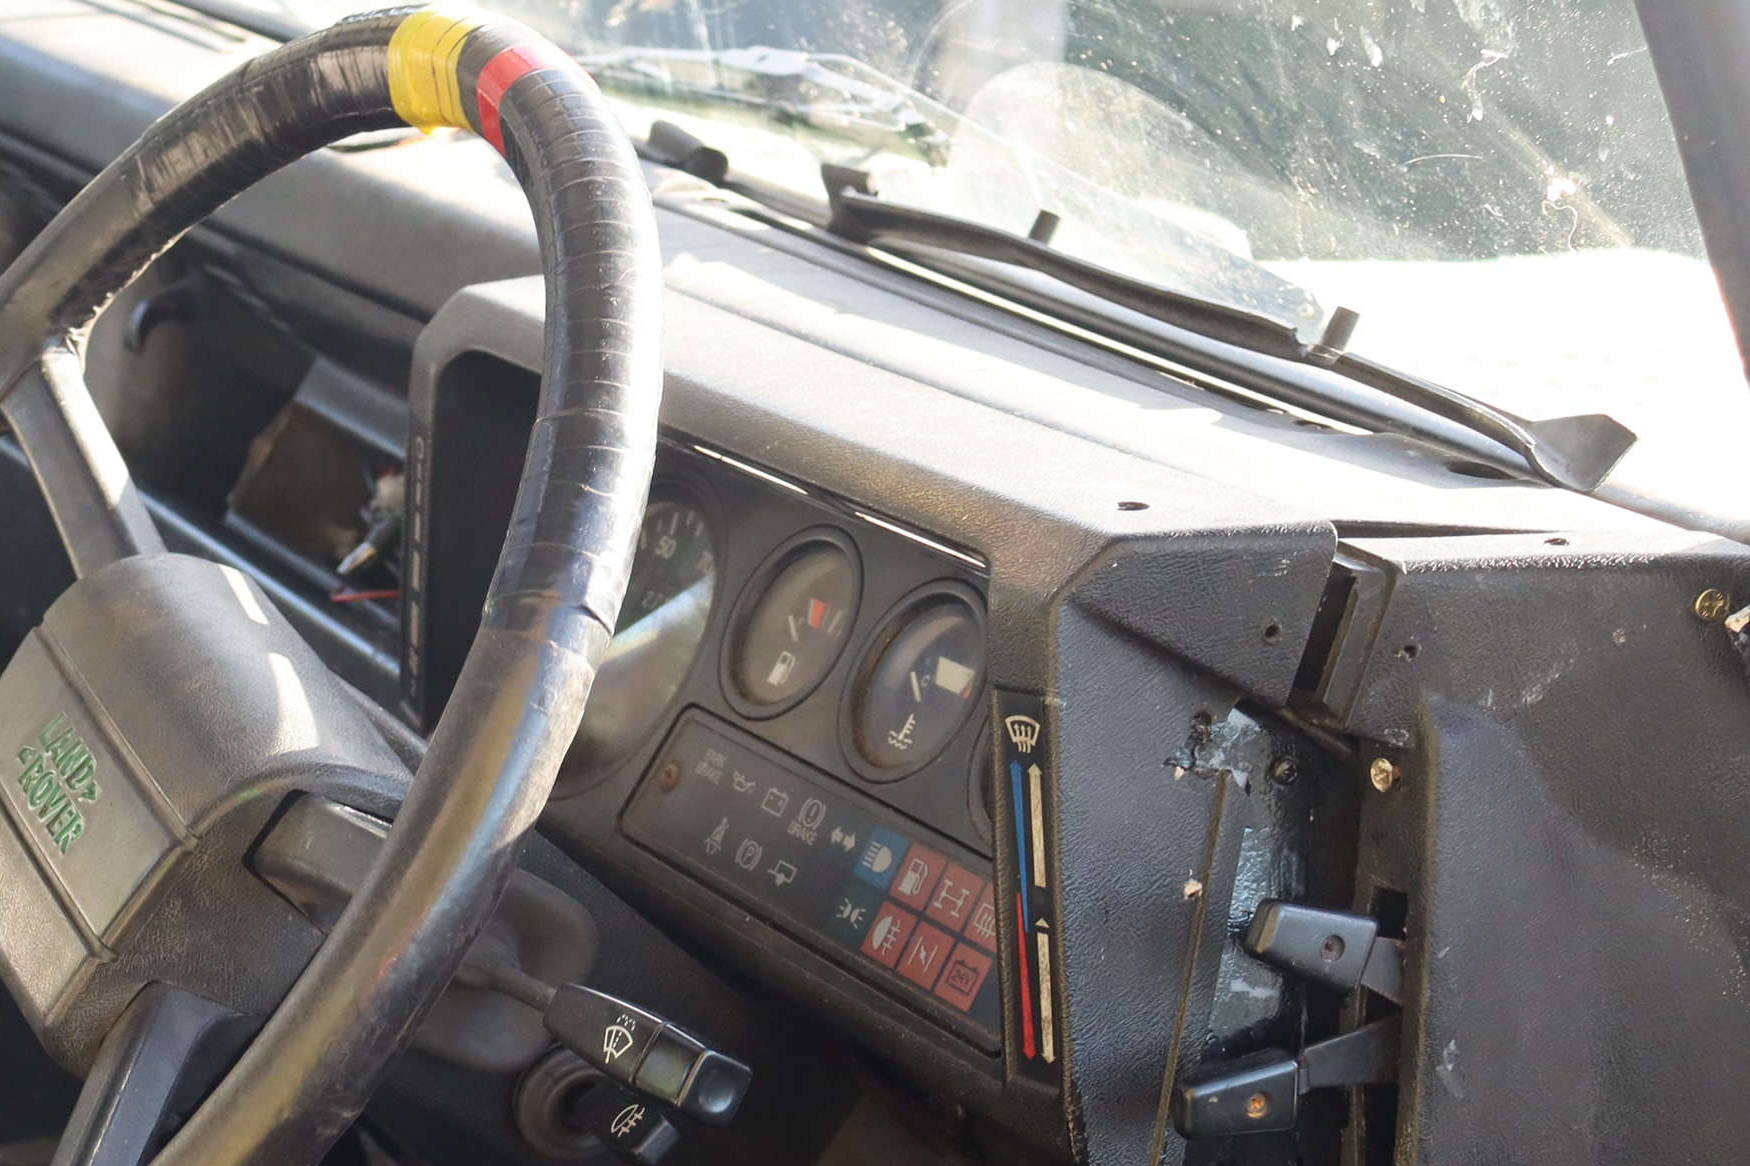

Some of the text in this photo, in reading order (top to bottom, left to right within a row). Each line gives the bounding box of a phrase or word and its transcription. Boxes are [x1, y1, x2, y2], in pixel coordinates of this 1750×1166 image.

[655, 535, 678, 559] 50
[38, 710, 97, 792] LAND
[694, 761, 724, 785] BRAKE
[16, 753, 85, 856] ROVER
[787, 820, 819, 846] BRAKE
[950, 968, 972, 987] 24V
